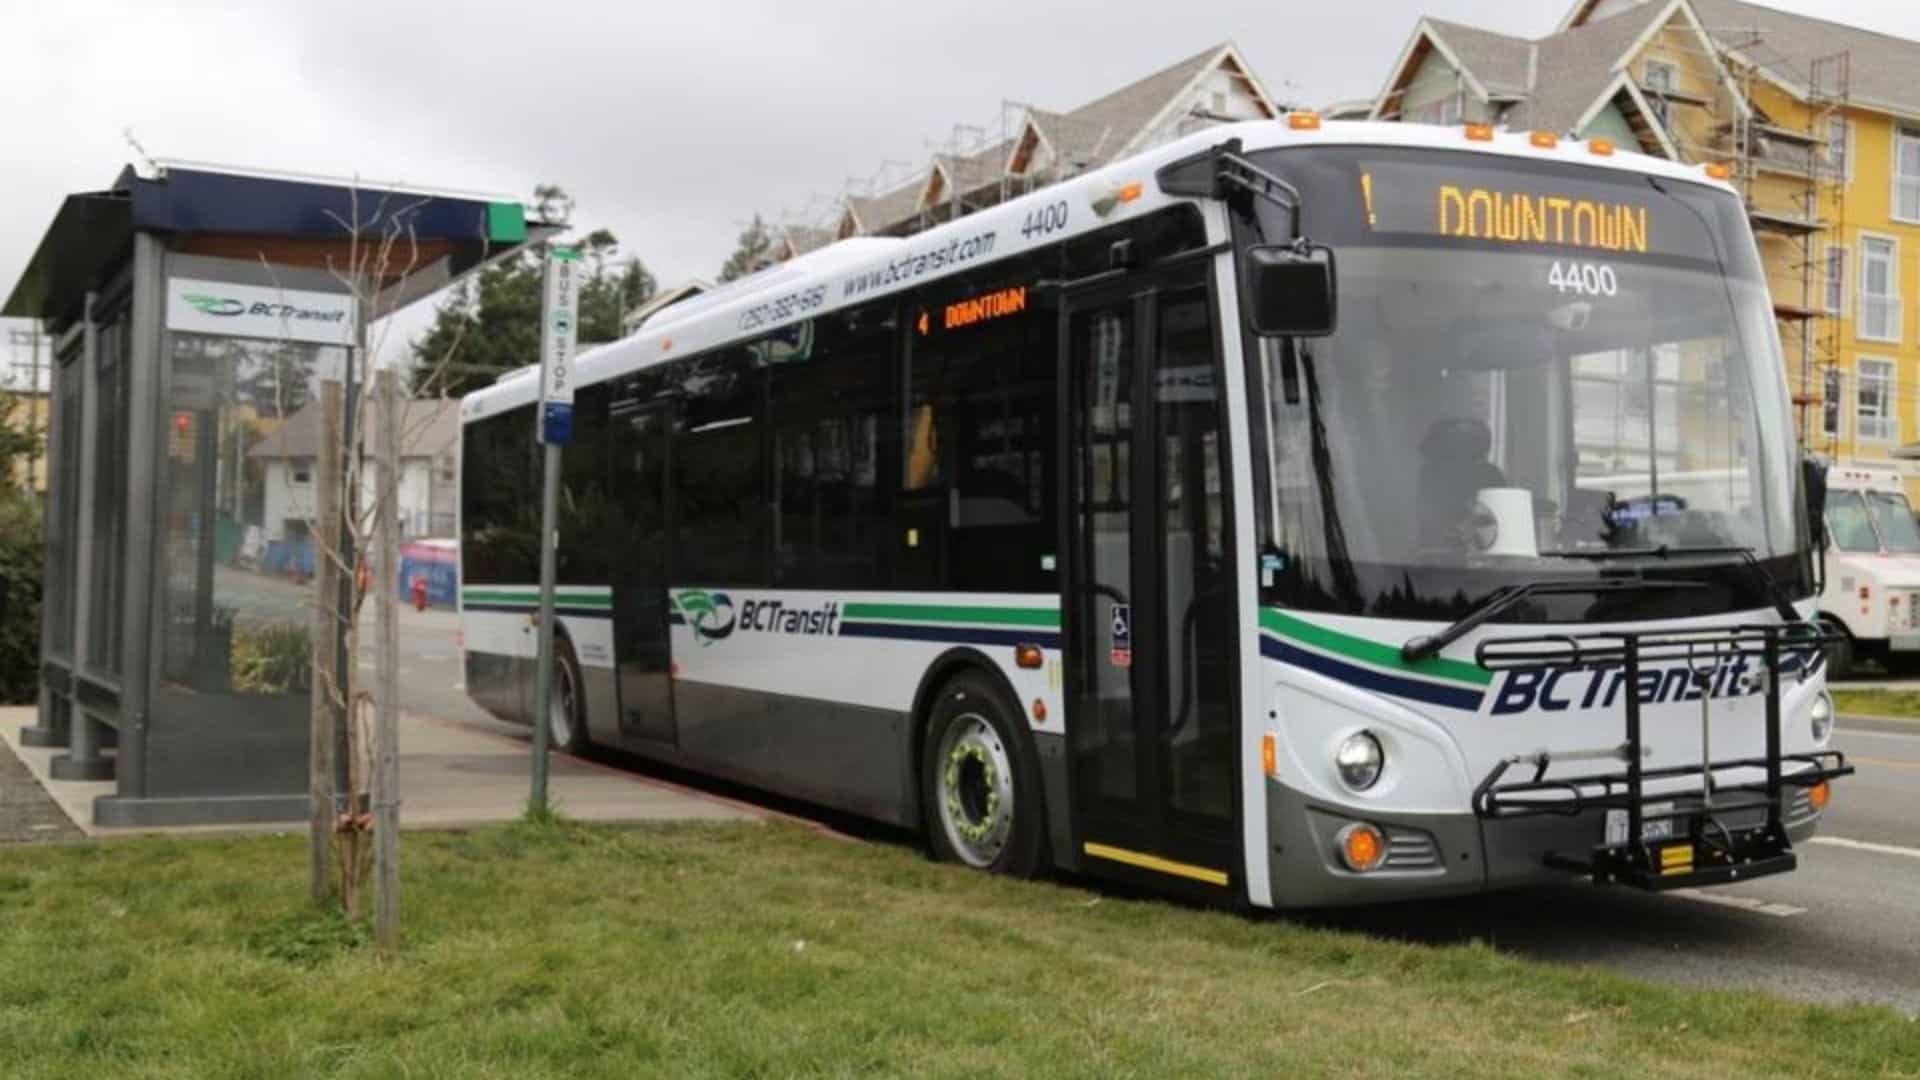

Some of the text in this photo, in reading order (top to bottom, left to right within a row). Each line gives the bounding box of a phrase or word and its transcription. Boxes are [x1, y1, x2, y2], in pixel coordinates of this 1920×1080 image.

[1439, 185, 1648, 252] DOWNTOWN
[843, 231, 996, 298] www.bctransit.com
[1021, 200, 1069, 239] 4400
[558, 264, 571, 307] BUS
[1548, 260, 1617, 296] 4400
[918, 286, 1026, 336] 4 DOWNTOWN
[554, 338, 568, 391] STOP
[738, 598, 838, 637] BCTransit
